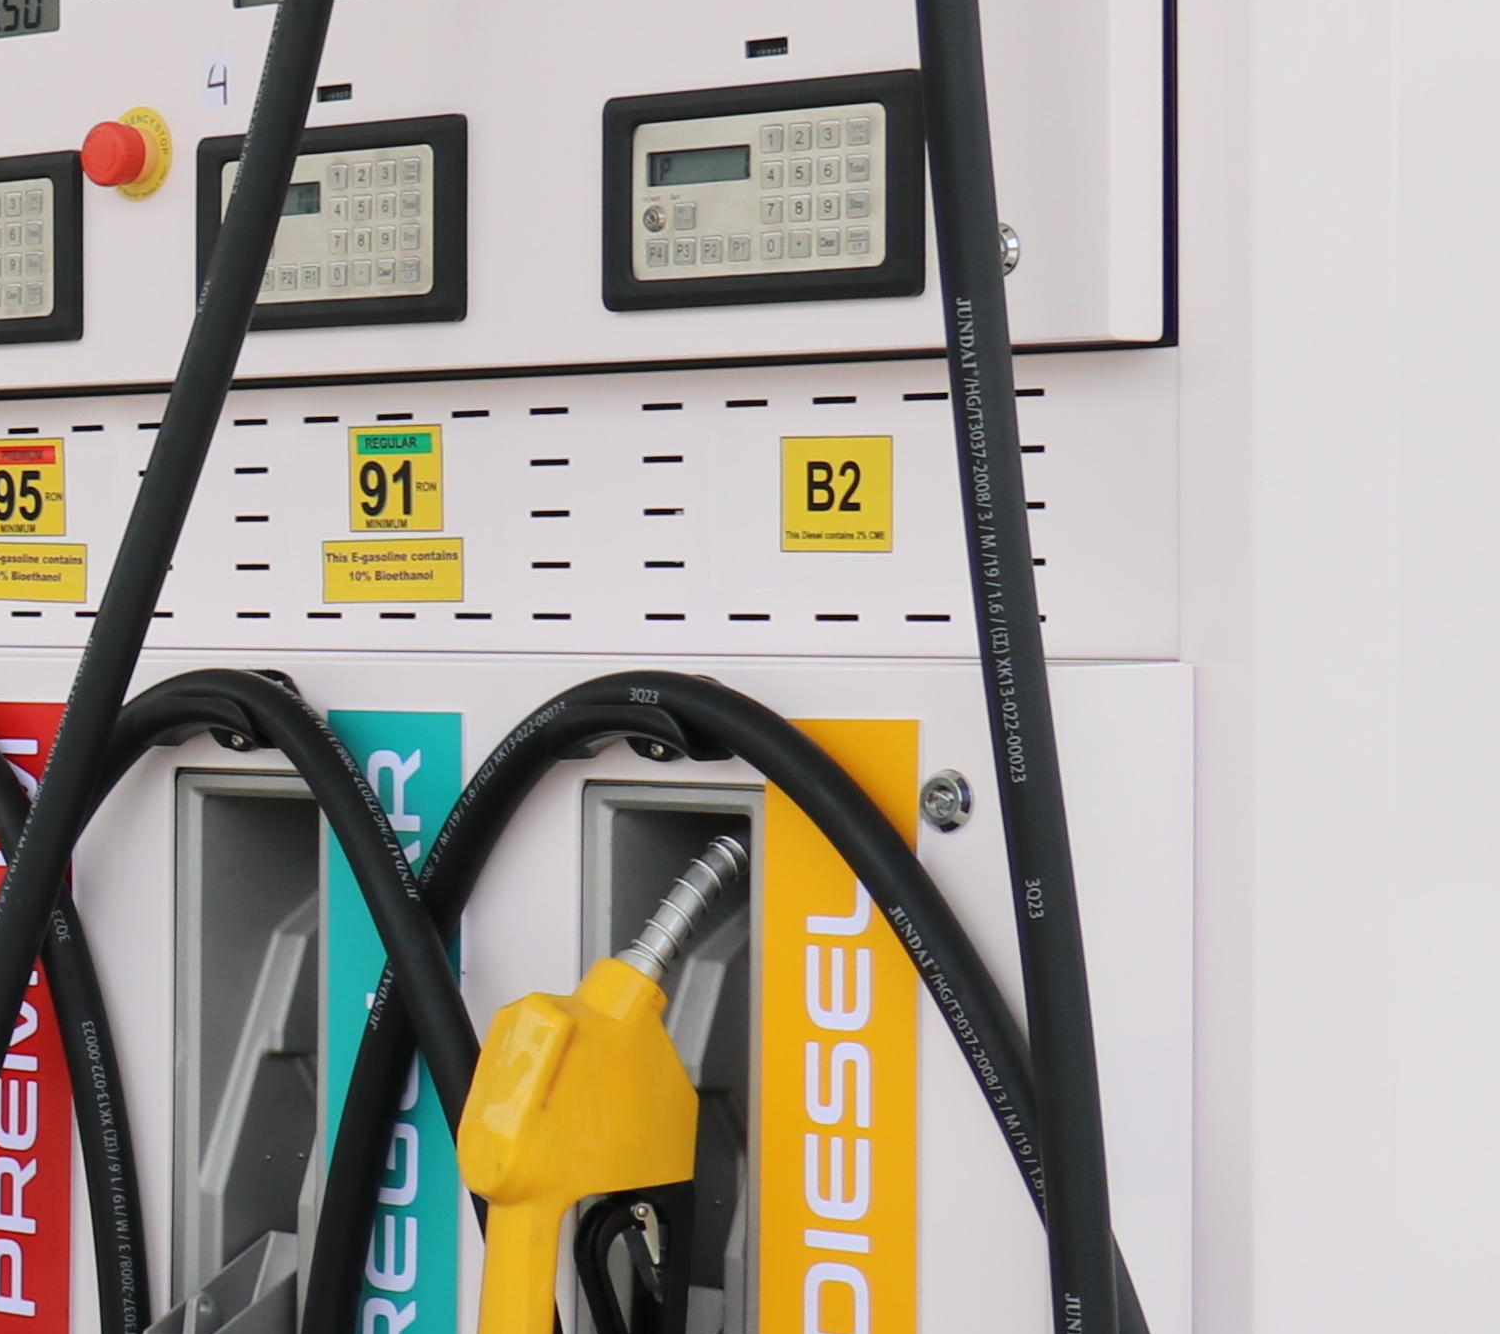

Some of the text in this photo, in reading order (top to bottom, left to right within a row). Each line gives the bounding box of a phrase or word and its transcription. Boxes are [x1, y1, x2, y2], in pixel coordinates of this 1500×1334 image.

[207, 63, 227, 105] 4
[155, 124, 169, 155] STOP
[767, 128, 832, 146] 1 2 3
[358, 169, 365, 182] 2
[382, 167, 388, 179] 3
[767, 169, 775, 182] 4
[795, 166, 803, 179] 5
[824, 164, 832, 177] 6
[334, 200, 388, 216] 4 5 6
[767, 203, 775, 216] 7
[795, 201, 803, 215] 8
[824, 199, 832, 213] 9
[334, 232, 388, 247] 7 8 9
[767, 240, 775, 253] 0
[365, 437, 417, 449] REGULAR
[359, 460, 412, 516] 91
[416, 482, 437, 492] RON
[805, 461, 862, 512] B2
[44, 492, 63, 501] RON
[0, 524, 37, 533] MINIMUM
[366, 519, 408, 528] MINIMUM
[42, 554, 83, 565] contains
[326, 550, 459, 565] This E-gasoline contains
[11, 571, 62, 582] Bioethanol
[349, 570, 434, 582] 10% Bioethanol
[628, 687, 660, 705] 3Q23
[1024, 878, 1044, 919] 3Q23
